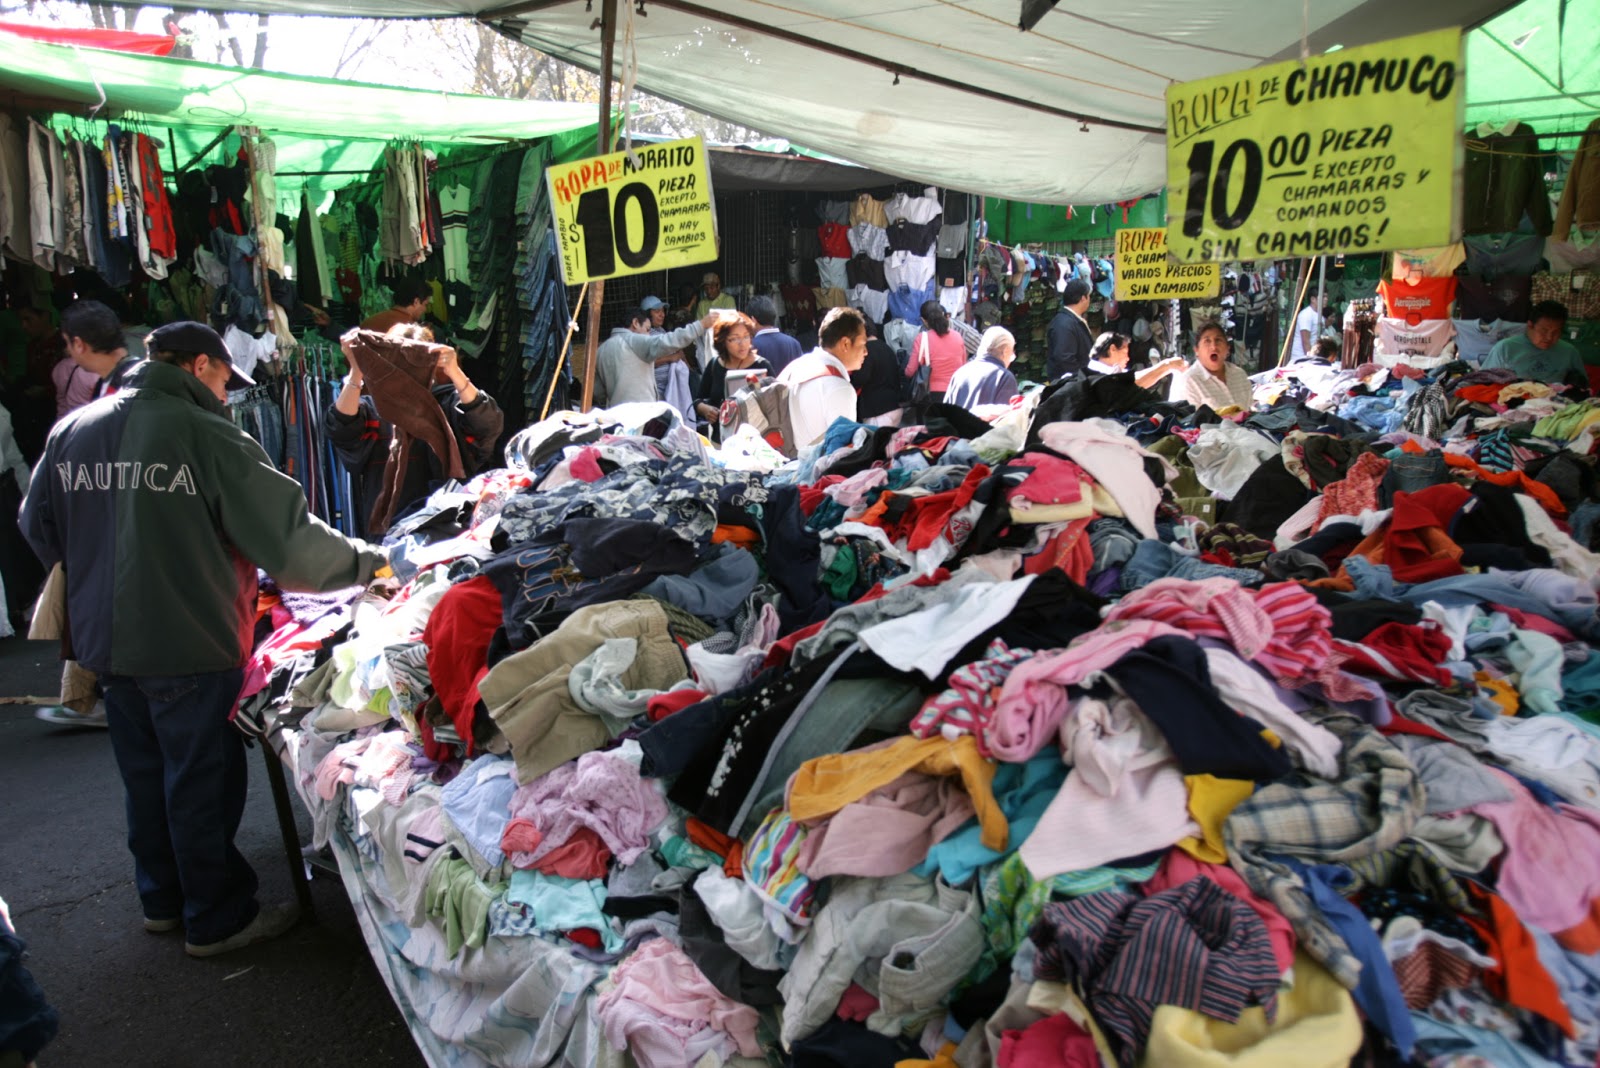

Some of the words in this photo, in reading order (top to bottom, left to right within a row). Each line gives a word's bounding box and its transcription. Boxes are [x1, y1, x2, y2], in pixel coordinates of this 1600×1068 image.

[1260, 77, 1279, 96] DE
[1285, 55, 1455, 105] CHAMUCO
[554, 160, 607, 205] ROPA
[608, 160, 622, 176] DE
[623, 146, 694, 176] MORRITO
[1312, 154, 1395, 179] EXCEPTO
[658, 174, 695, 194] PIEZA
[1183, 138, 1263, 237] 10
[1319, 124, 1393, 156] PIEZA
[1283, 172, 1406, 201] CHAMARRAS
[659, 203, 711, 219] CHAMARRAS
[660, 192, 697, 206] EXCEPTO
[1277, 196, 1386, 222] COMANDOS
[663, 223, 675, 234] NO
[679, 221, 699, 231] HAY
[664, 232, 706, 245] CAMBIOS
[1256, 218, 1389, 255] CAMBIOS!
[1120, 231, 1162, 253] ROPA
[1122, 268, 1161, 280] VARIOS
[1166, 266, 1212, 278] PRECIOS
[56, 461, 196, 495] NAUTICA
